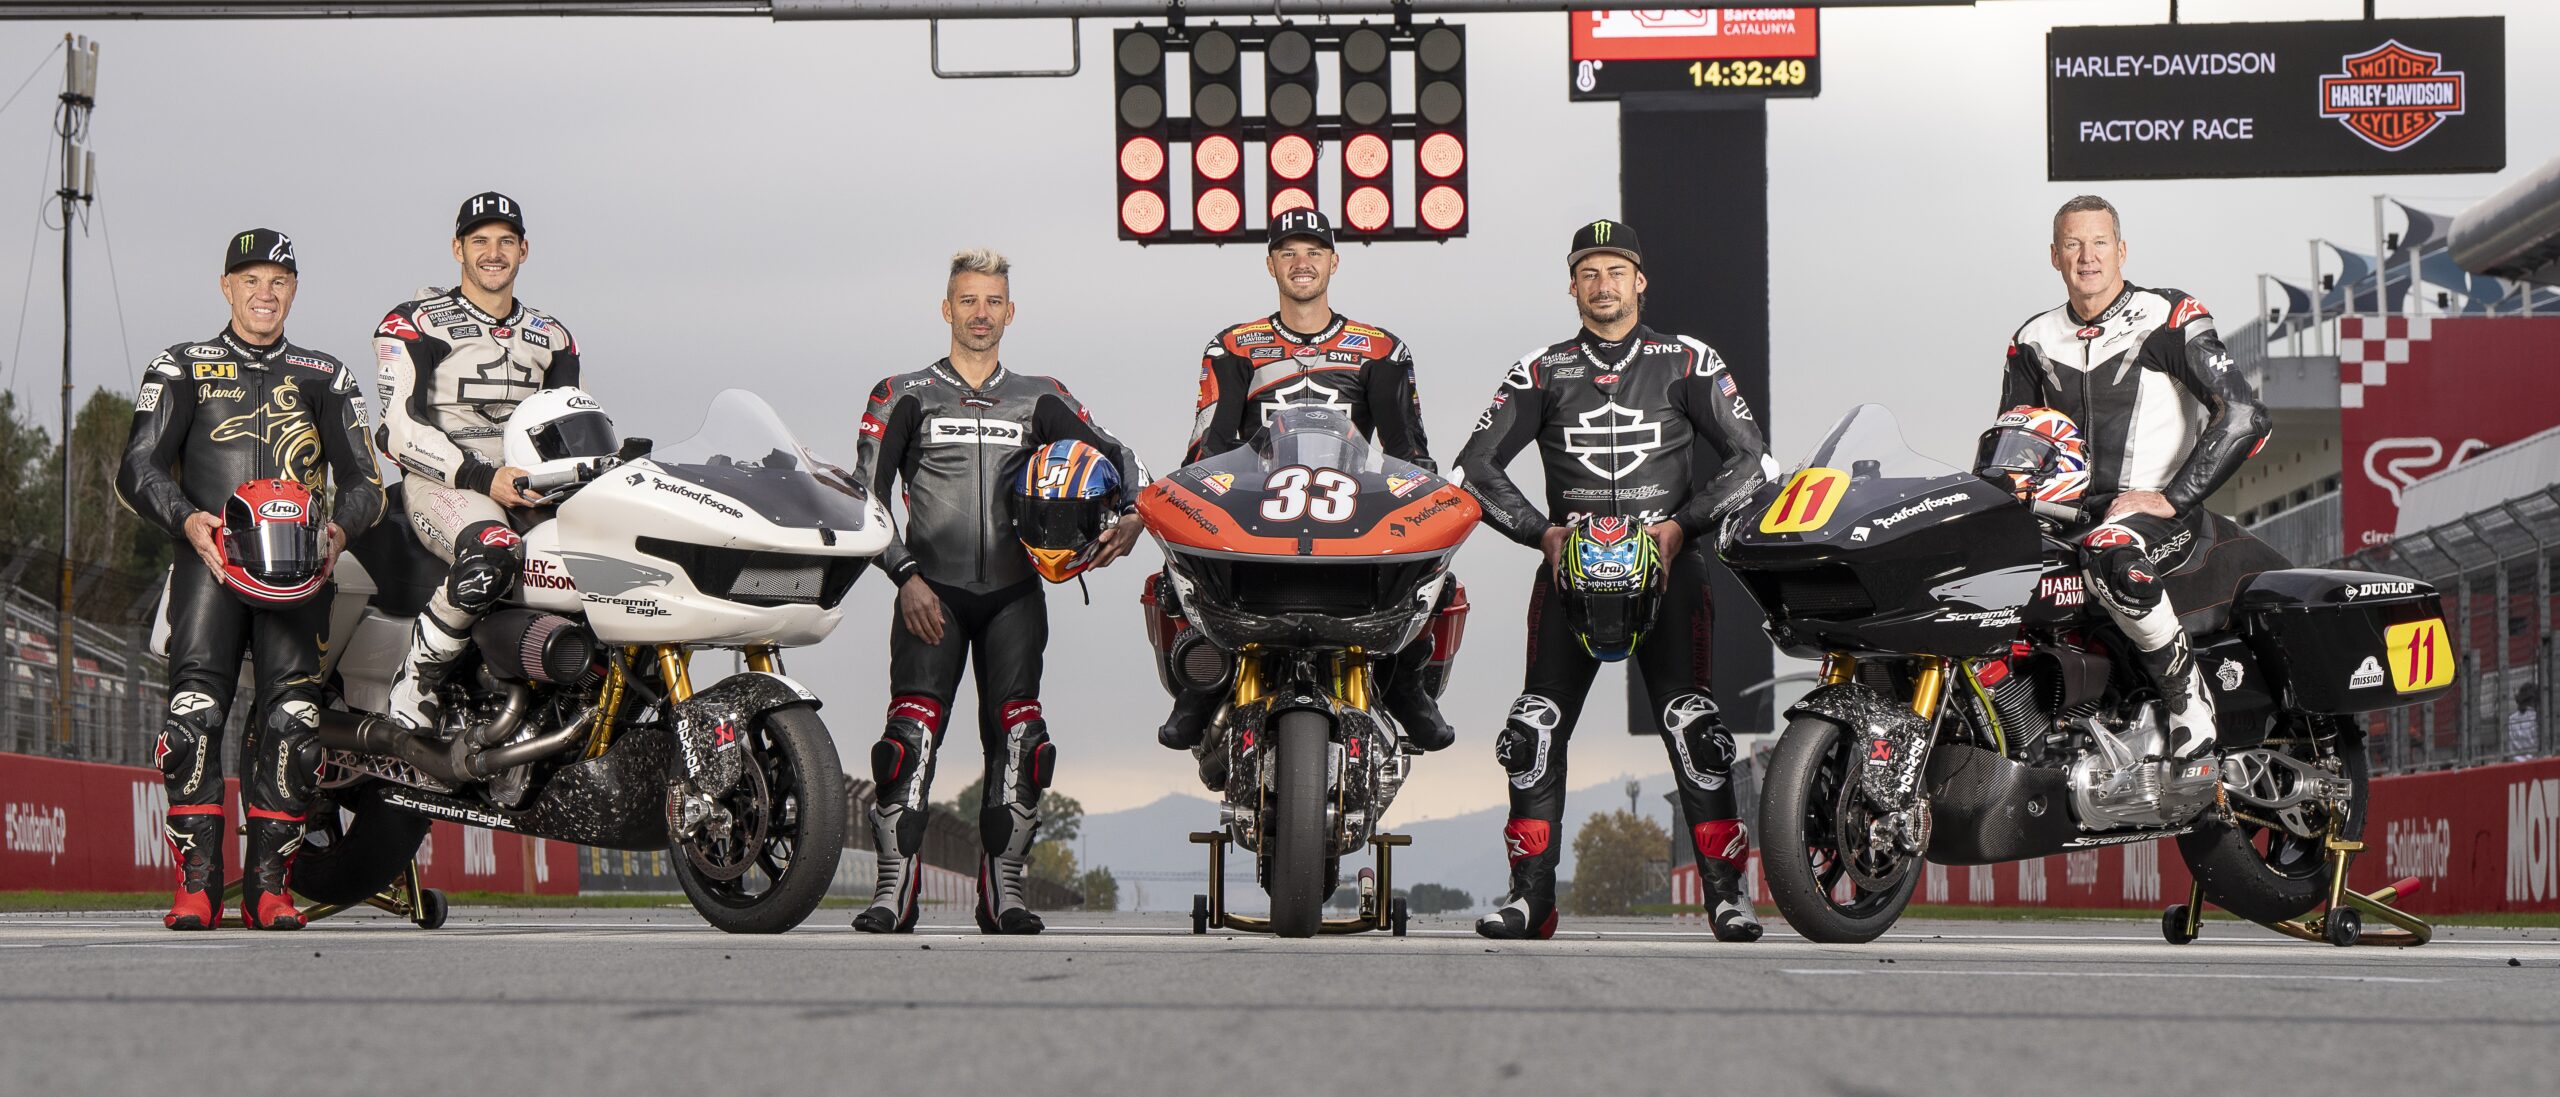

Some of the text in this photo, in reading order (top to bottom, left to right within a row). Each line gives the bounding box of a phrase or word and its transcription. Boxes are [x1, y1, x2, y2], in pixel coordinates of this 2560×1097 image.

[1723, 8, 1796, 21] Barcelona
[1723, 23, 1796, 35] CATALUNYA
[1689, 59, 1806, 86] 14:32:49
[2055, 52, 2276, 78] HARLEY-DAVIDSON
[2360, 52, 2425, 77] MOTOR
[2331, 82, 2454, 107] HARLEY-DAVIDSON
[2079, 118, 2253, 142] FACTORY RACE
[2360, 112, 2425, 140] CYCLES
[524, 331, 547, 346] SYN3
[1329, 351, 1359, 362] SYN3
[1643, 343, 1682, 355] SYN3
[195, 363, 235, 379] PJ1
[198, 383, 247, 403] Randy
[937, 424, 1019, 438] SPIDI
[653, 476, 702, 502] Rockford
[1261, 465, 1360, 523] 33
[262, 502, 298, 514] Arai
[1774, 475, 1836, 526] 11
[1872, 500, 1928, 529] Rockford
[1591, 562, 1621, 574] Arai
[523, 574, 577, 591] AVIDSON
[2041, 575, 2084, 599] HARLE
[2359, 582, 2415, 597] DUNLOP
[580, 594, 659, 607] Screamin'
[2055, 590, 2084, 607] DAVI
[625, 606, 672, 618] Eagle
[1934, 606, 2017, 624] Screamin'
[1978, 615, 2022, 628] Eagle
[2407, 624, 2434, 688] 11
[678, 718, 702, 779] DUNLOP
[1898, 737, 1926, 794] DUNLOP
[2181, 766, 2210, 780] 131R
[384, 793, 515, 829] Screamin' Eagle
[5, 802, 67, 866] #SolidarityGP
[2386, 817, 2451, 893] #SolidarityGP
